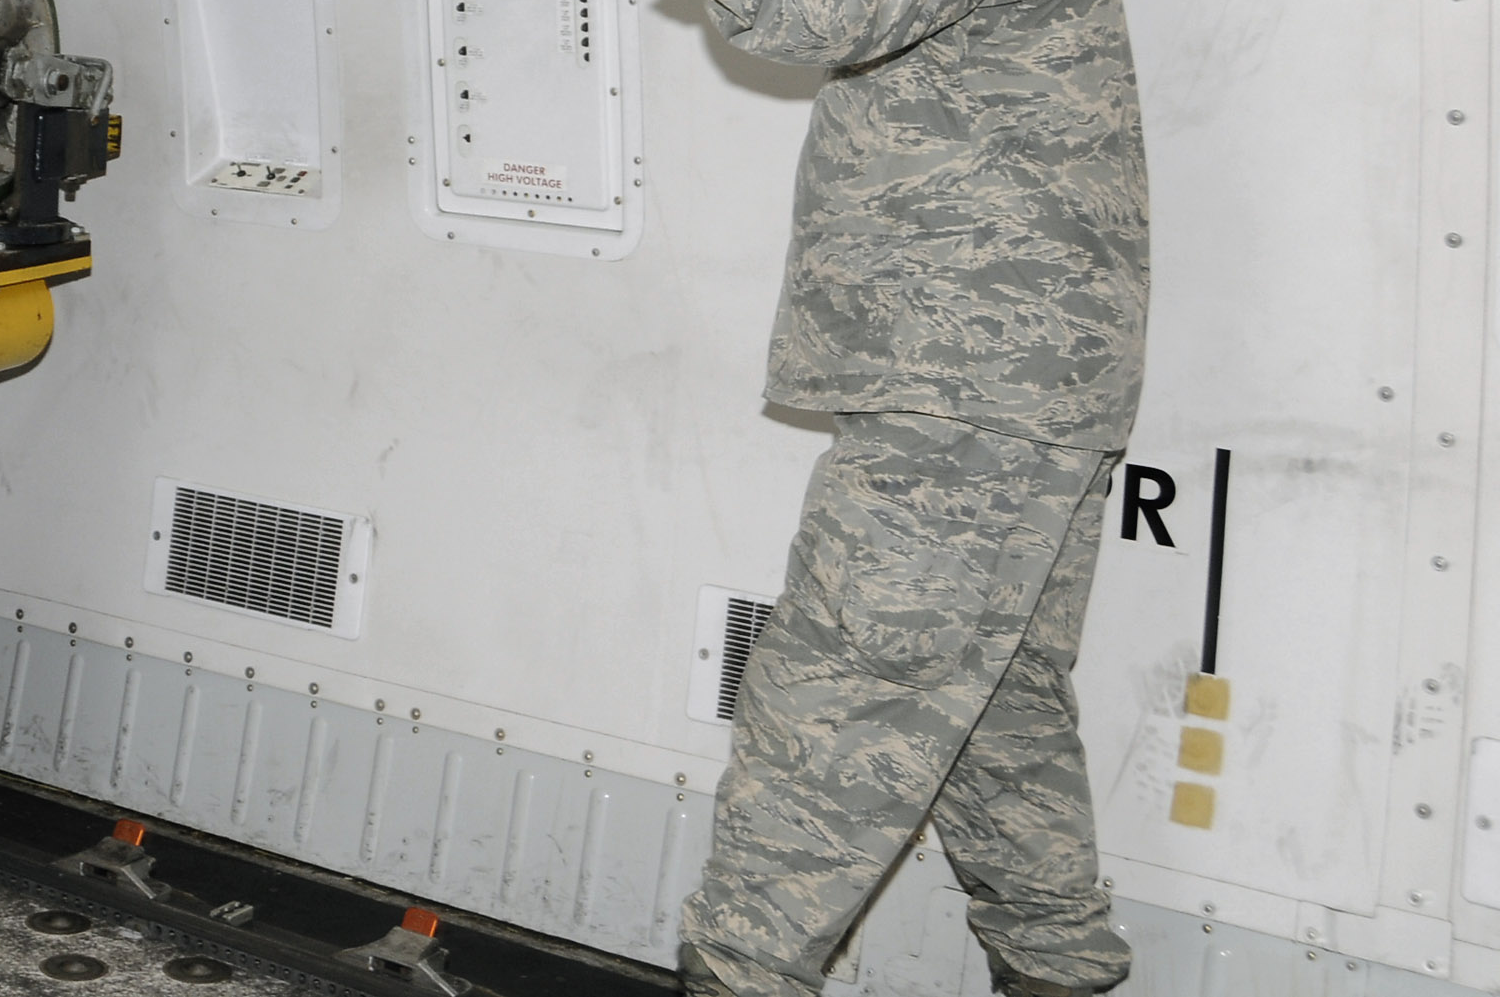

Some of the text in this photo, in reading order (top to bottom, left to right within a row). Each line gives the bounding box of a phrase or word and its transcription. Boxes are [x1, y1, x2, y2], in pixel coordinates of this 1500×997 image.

[503, 162, 546, 176] DANGER
[487, 172, 563, 189] HIGH VOLTAGE
